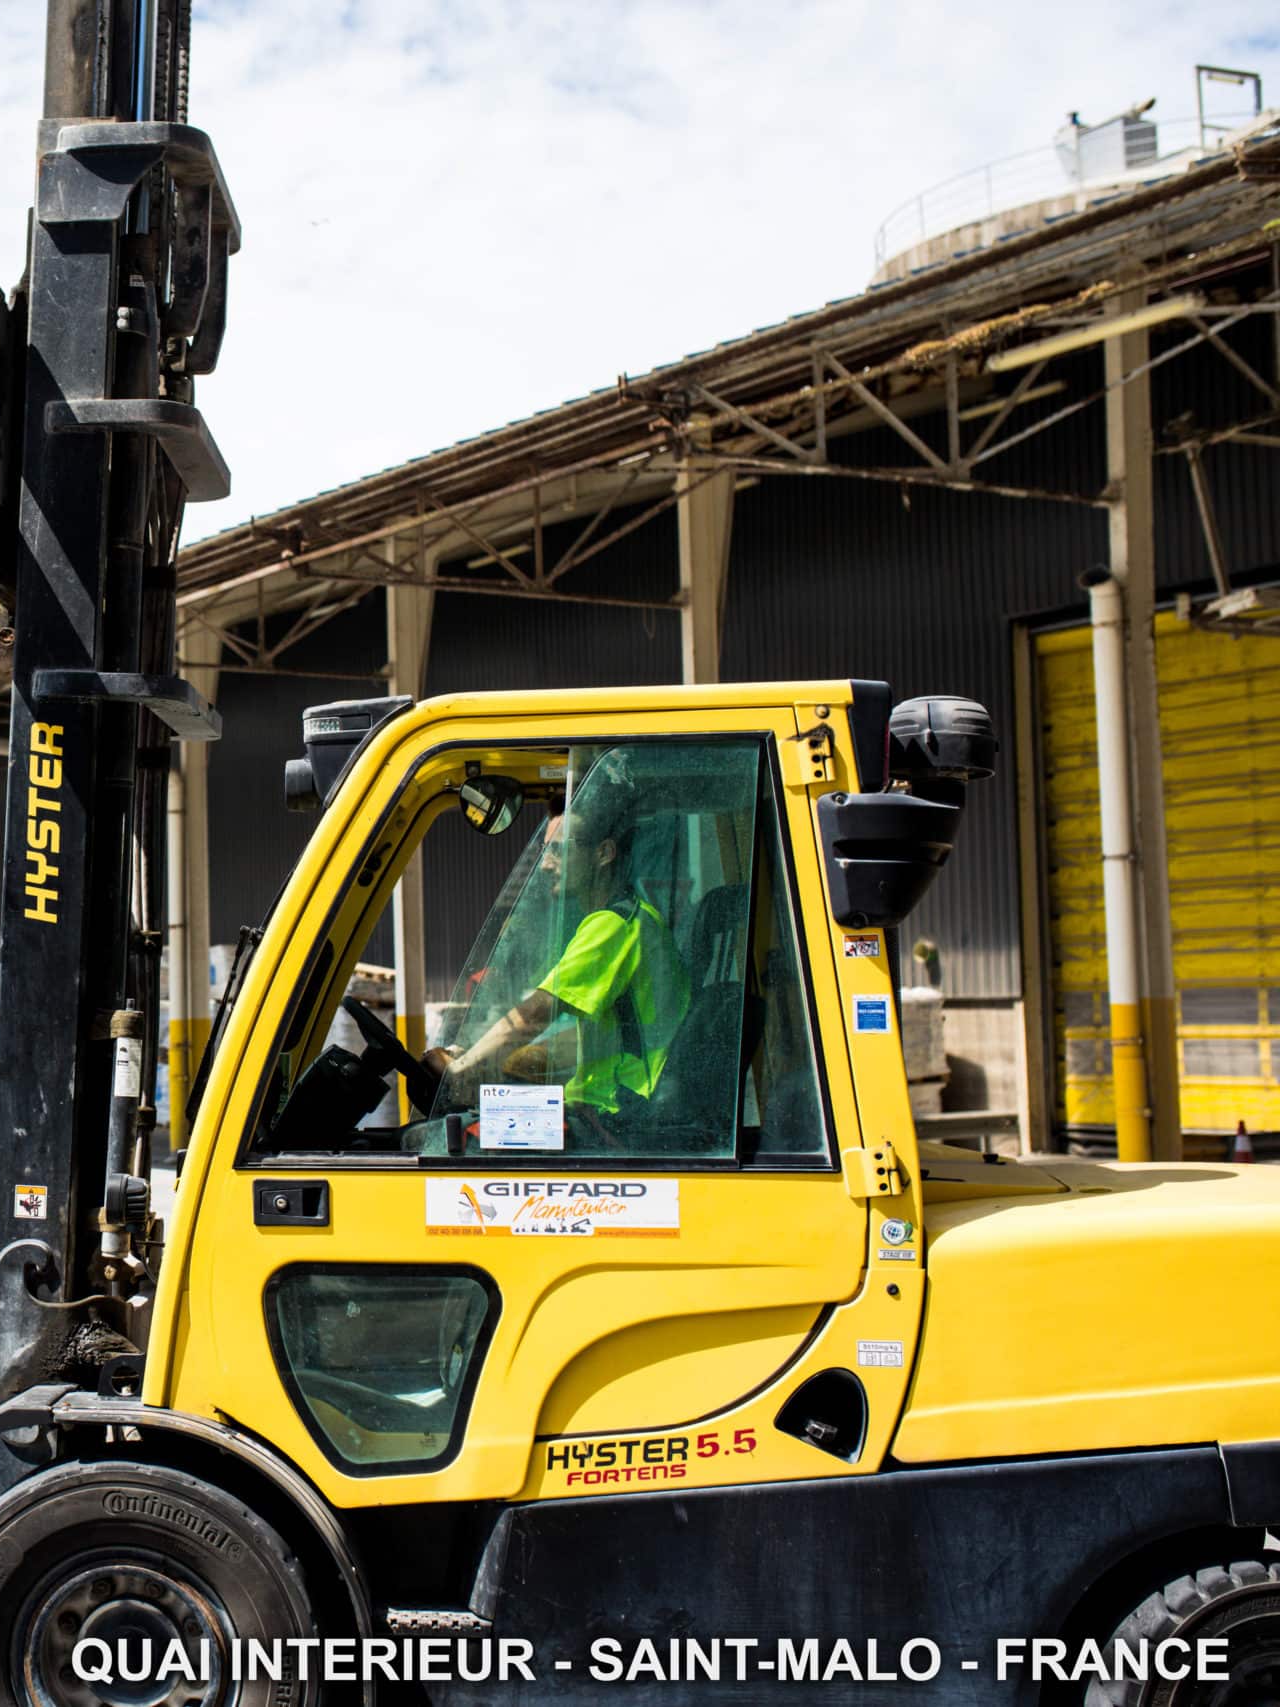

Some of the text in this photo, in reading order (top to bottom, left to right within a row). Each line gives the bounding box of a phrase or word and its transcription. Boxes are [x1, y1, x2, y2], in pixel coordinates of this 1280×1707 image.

[24, 721, 64, 924] HYSTER
[483, 1182, 648, 1198] GIFFARD
[513, 1195, 628, 1222] Manutention
[547, 1428, 757, 1470] HYSTER 5.5
[566, 1463, 687, 1486] FORTENS
[102, 1490, 232, 1551] Continental
